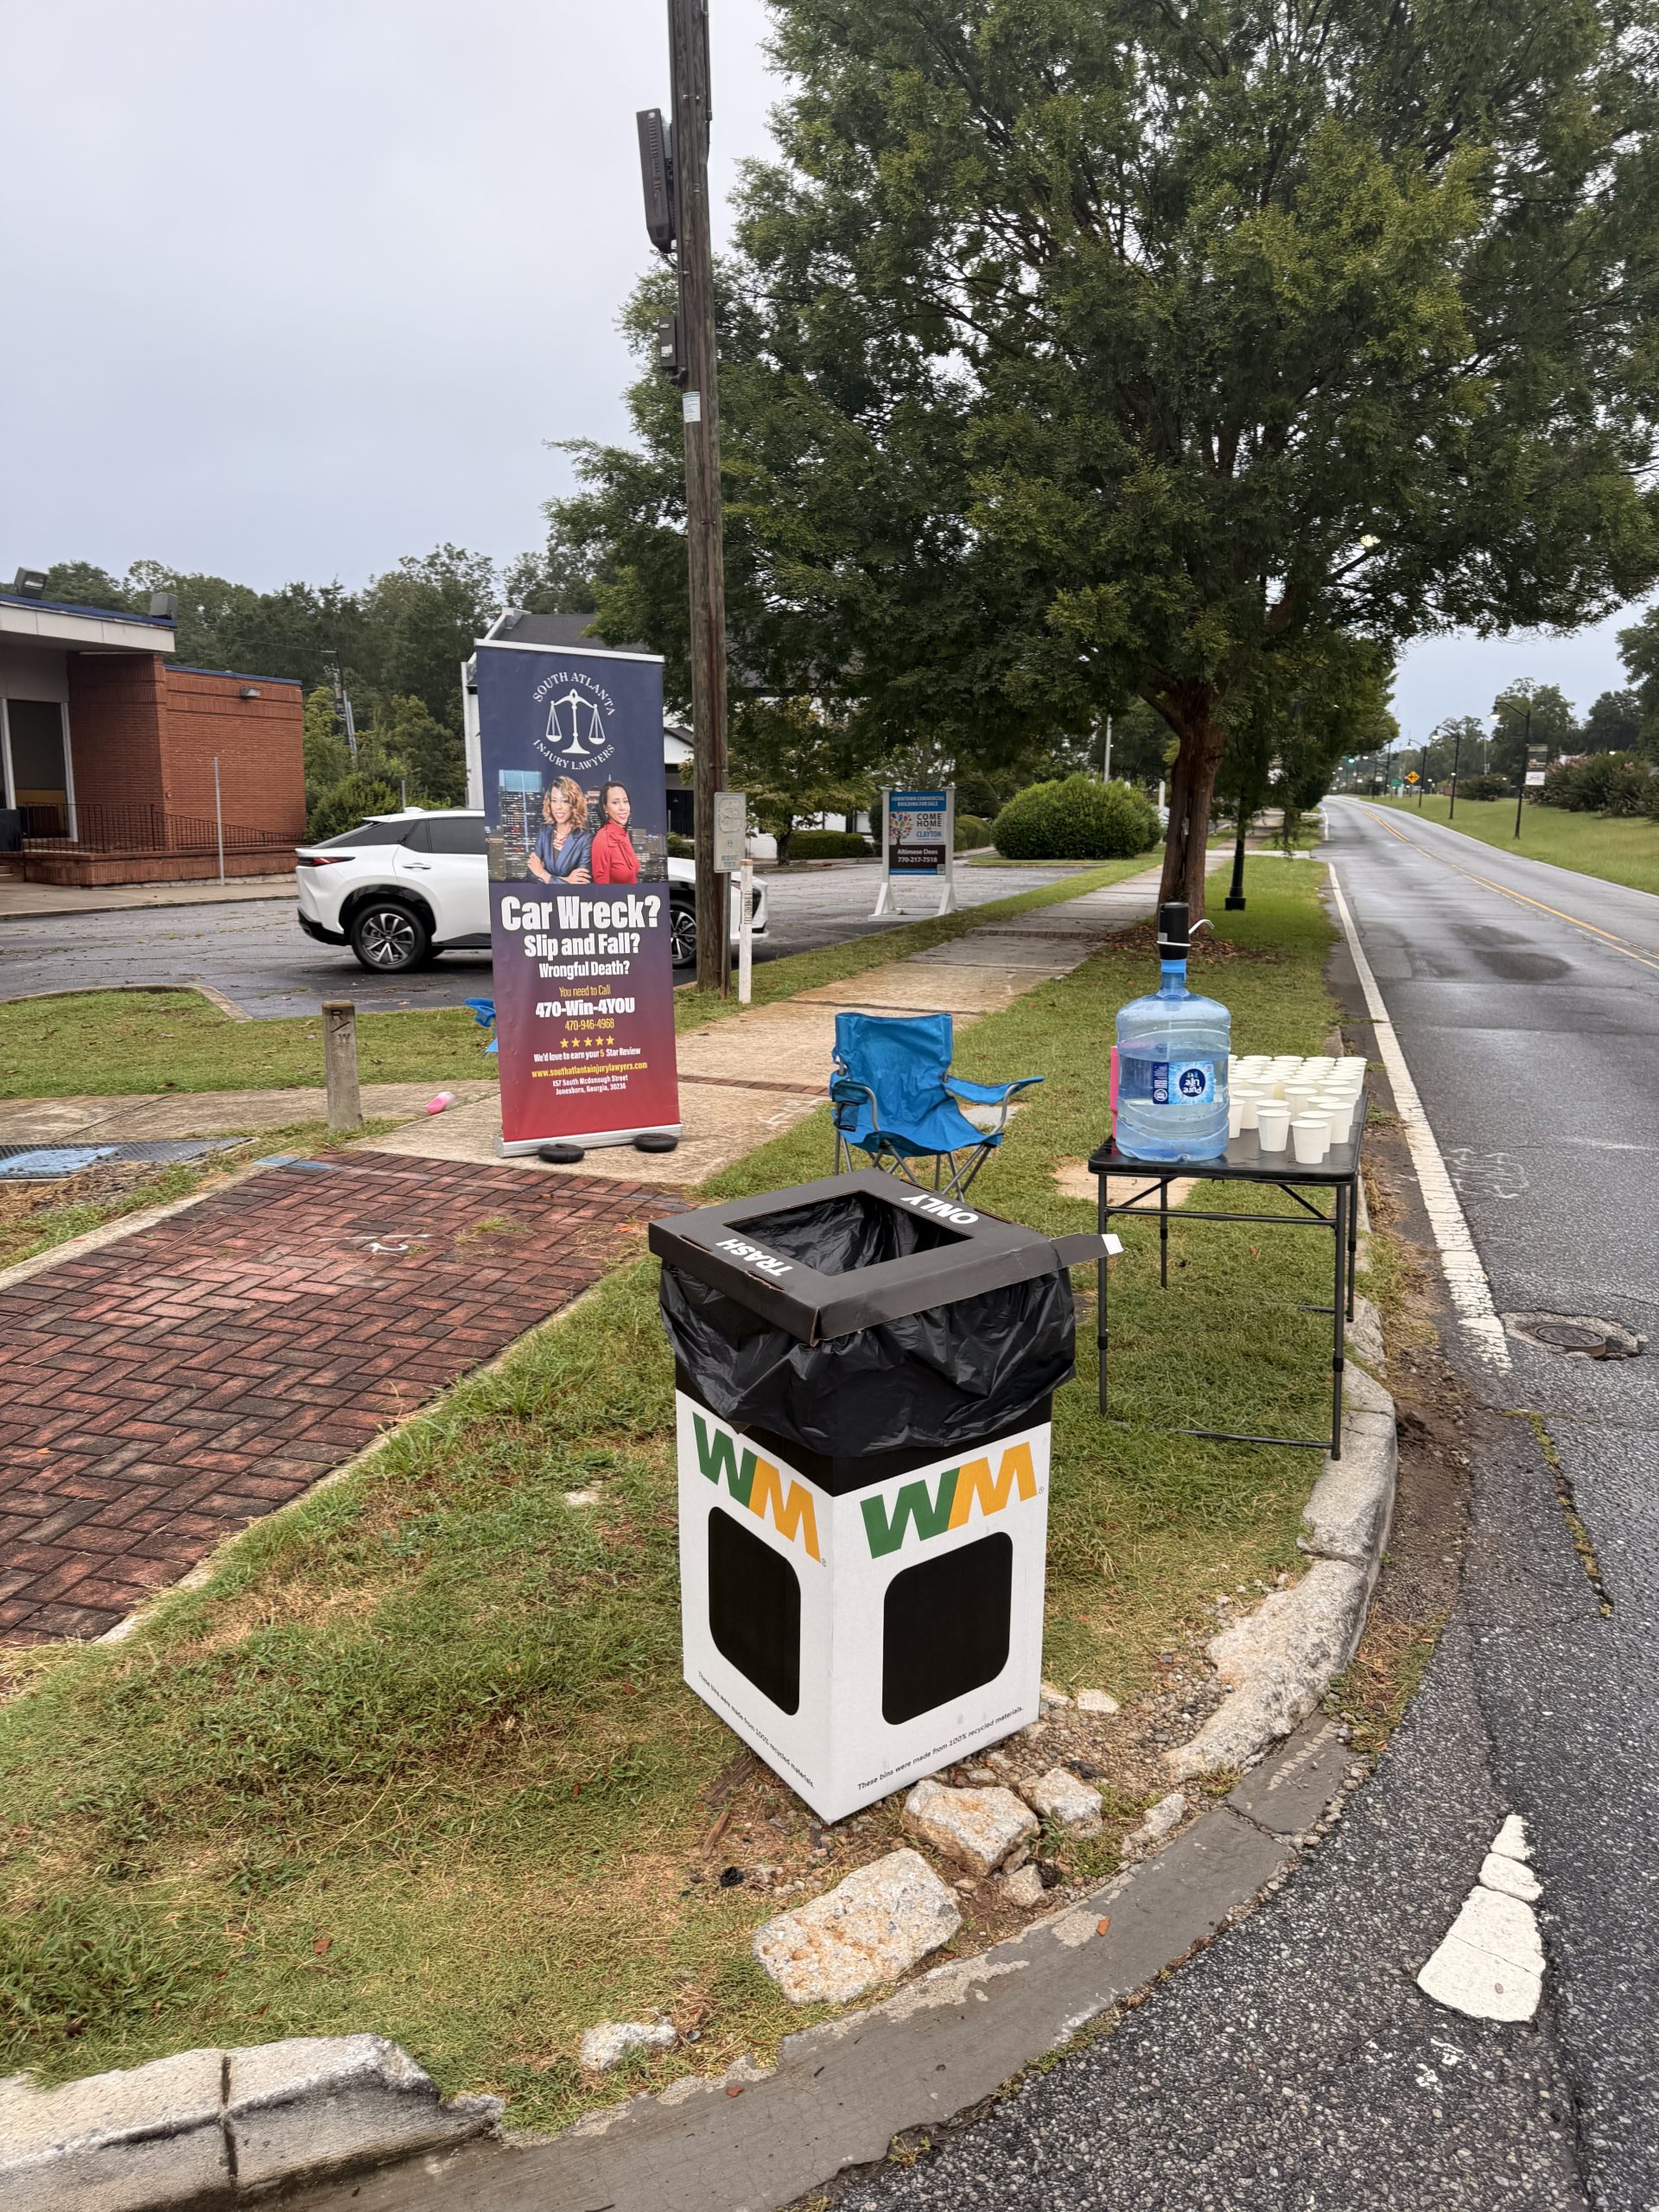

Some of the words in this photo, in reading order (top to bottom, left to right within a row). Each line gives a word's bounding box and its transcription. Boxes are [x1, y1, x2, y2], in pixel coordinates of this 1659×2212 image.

[533, 672, 569, 702] SOUTH
[571, 672, 615, 715] ATLANTA
[533, 740, 569, 768] INJURY
[571, 744, 614, 770] LAWYERS
[501, 895, 552, 931] Car
[556, 894, 661, 930] Wreck?
[524, 934, 558, 961] Slip
[562, 933, 594, 956] and
[598, 932, 640, 954] Fall?
[539, 962, 588, 980] Wrongful
[591, 960, 630, 976] Death?
[559, 987, 571, 996] You
[573, 986, 589, 995] need
[590, 986, 597, 995] to
[598, 984, 611, 995] Call
[535, 997, 635, 1018] 470-Win-4YOU
[565, 1018, 614, 1031] 470-946-4968
[533, 1053, 549, 1063] We'd
[550, 1052, 563, 1061] love
[563, 1052, 570, 1060] to
[585, 1051, 599, 1060] your
[600, 1049, 605, 1058] 5
[606, 1048, 619, 1057] Star
[620, 1046, 641, 1056] Review
[531, 1062, 647, 1078] www.southatlantainjurylawyers.com
[563, 1077, 579, 1086] South
[1184, 1077, 1200, 1087] Life
[899, 1194, 978, 1224] ONLY
[715, 1238, 794, 1276] TRASH
[692, 1411, 822, 1563] WM
[860, 1441, 1037, 1559] WM
[698, 1670, 710, 1688] These
[710, 1683, 720, 1697] bins
[720, 1695, 731, 1708] were
[731, 1705, 744, 1720] made
[744, 1717, 755, 1732] from
[756, 1728, 769, 1745] 100%
[770, 1743, 790, 1765] recycled
[858, 1777, 878, 1790] These
[879, 1769, 894, 1781] bins
[895, 1761, 912, 1773] were
[912, 1751, 931, 1764] made
[932, 1743, 948, 1755] from
[949, 1733, 967, 1747] 100%
[968, 1719, 995, 1738] recycled
[995, 1706, 1024, 1724] materials.
